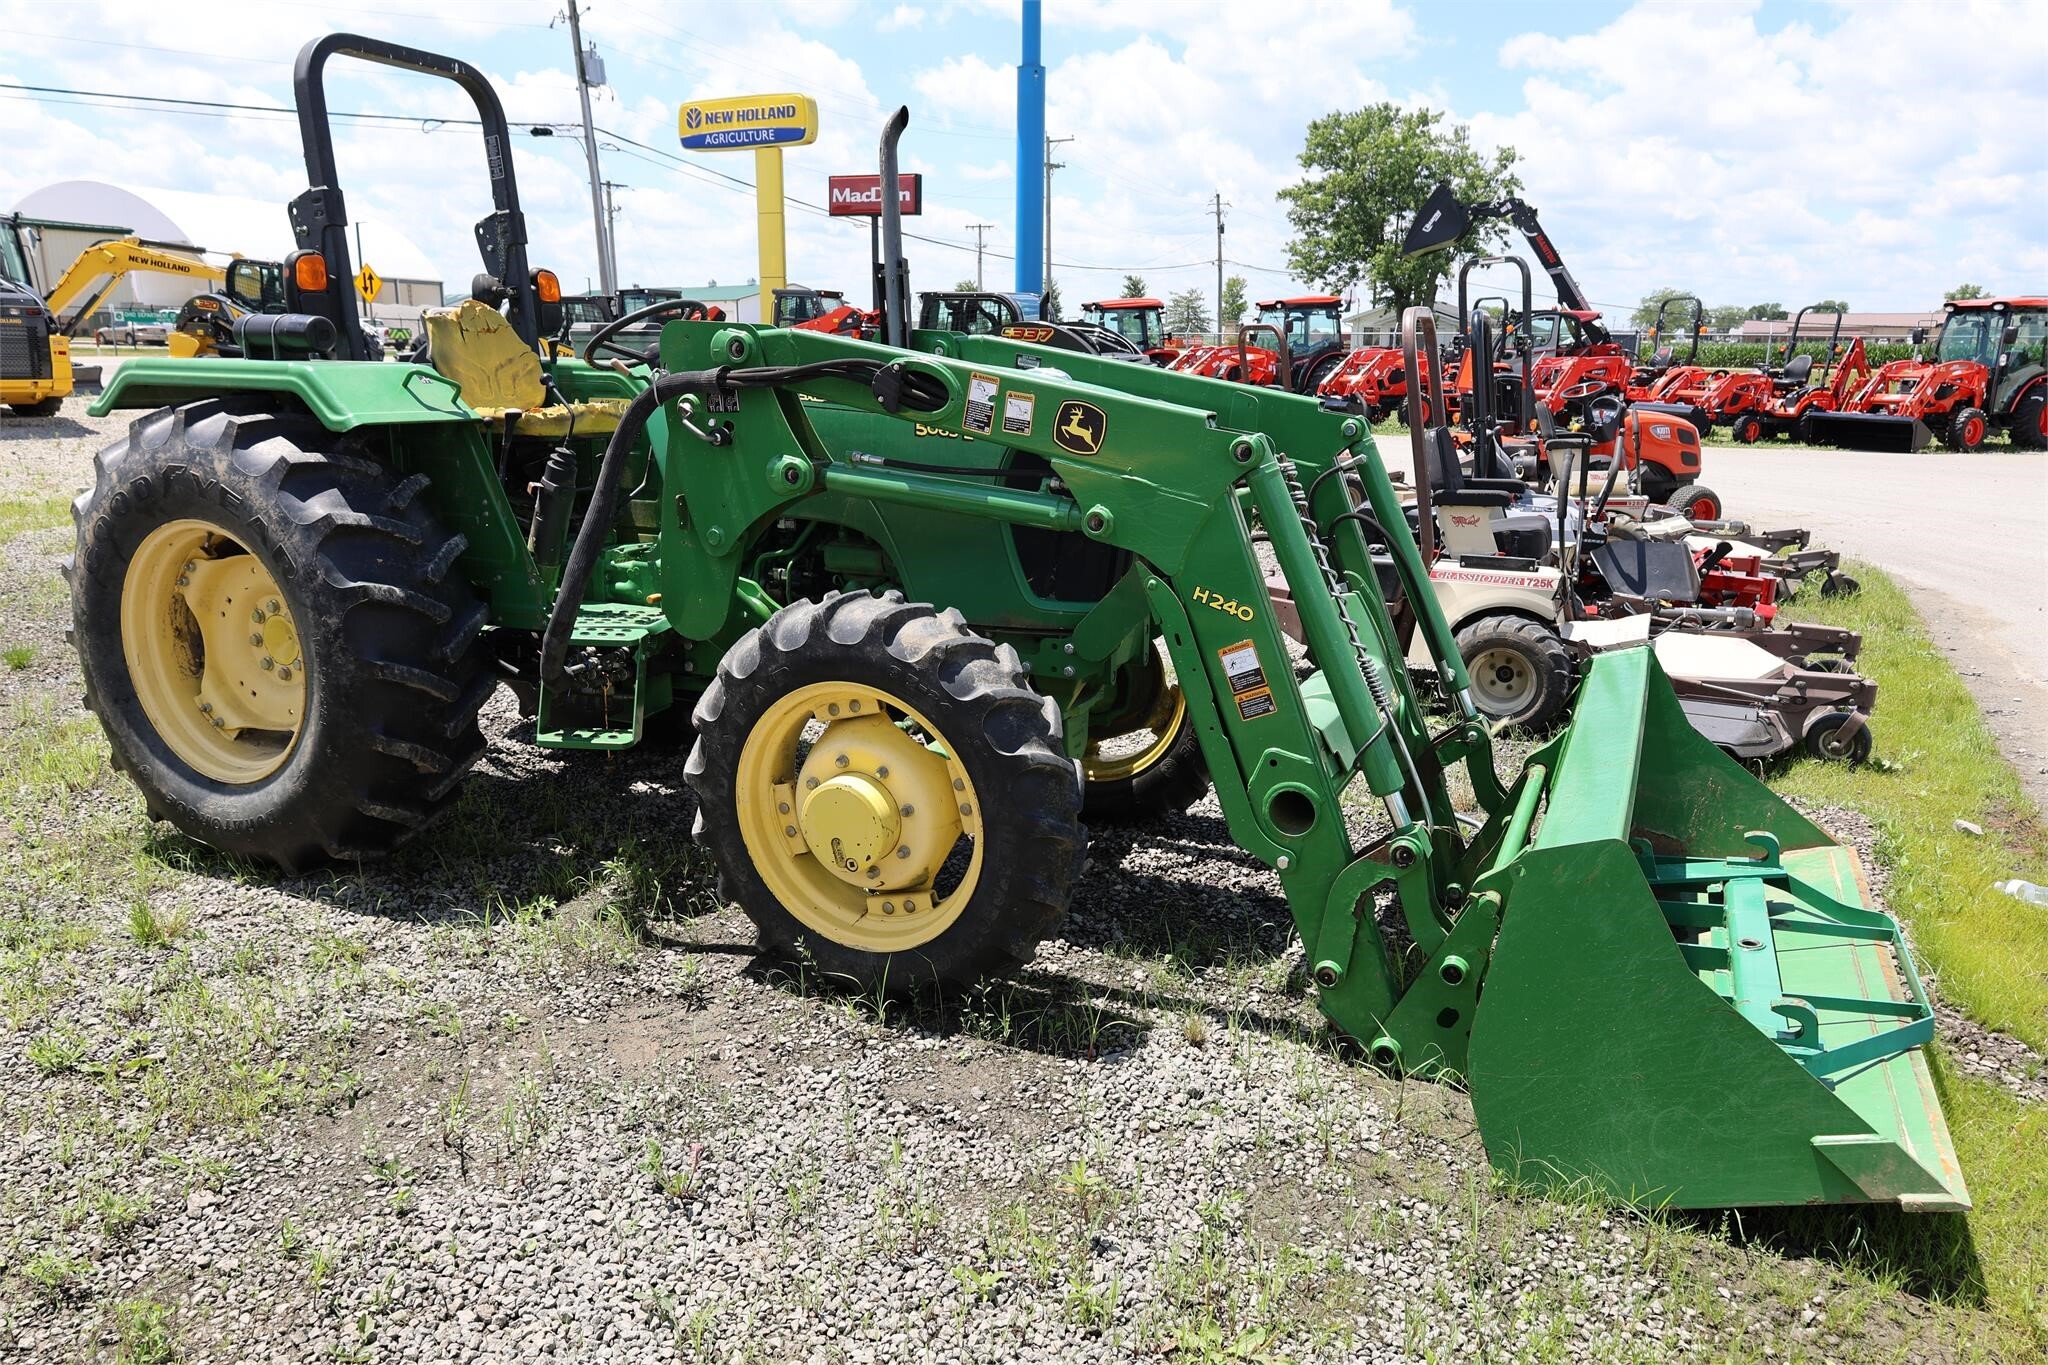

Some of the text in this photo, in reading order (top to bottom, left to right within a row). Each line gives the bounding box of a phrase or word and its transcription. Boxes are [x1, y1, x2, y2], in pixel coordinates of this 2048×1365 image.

[705, 105, 796, 125] NEW HOLLAND
[704, 129, 775, 145] AGRICULTURE
[832, 187, 911, 203] MacDn
[128, 255, 191, 273] NEW HOLLAND
[1001, 326, 1055, 342] C337
[1435, 570, 1554, 588] GRASSHOPPER 725K
[1193, 586, 1254, 621] H240
[1227, 642, 1250, 653] WARNING
